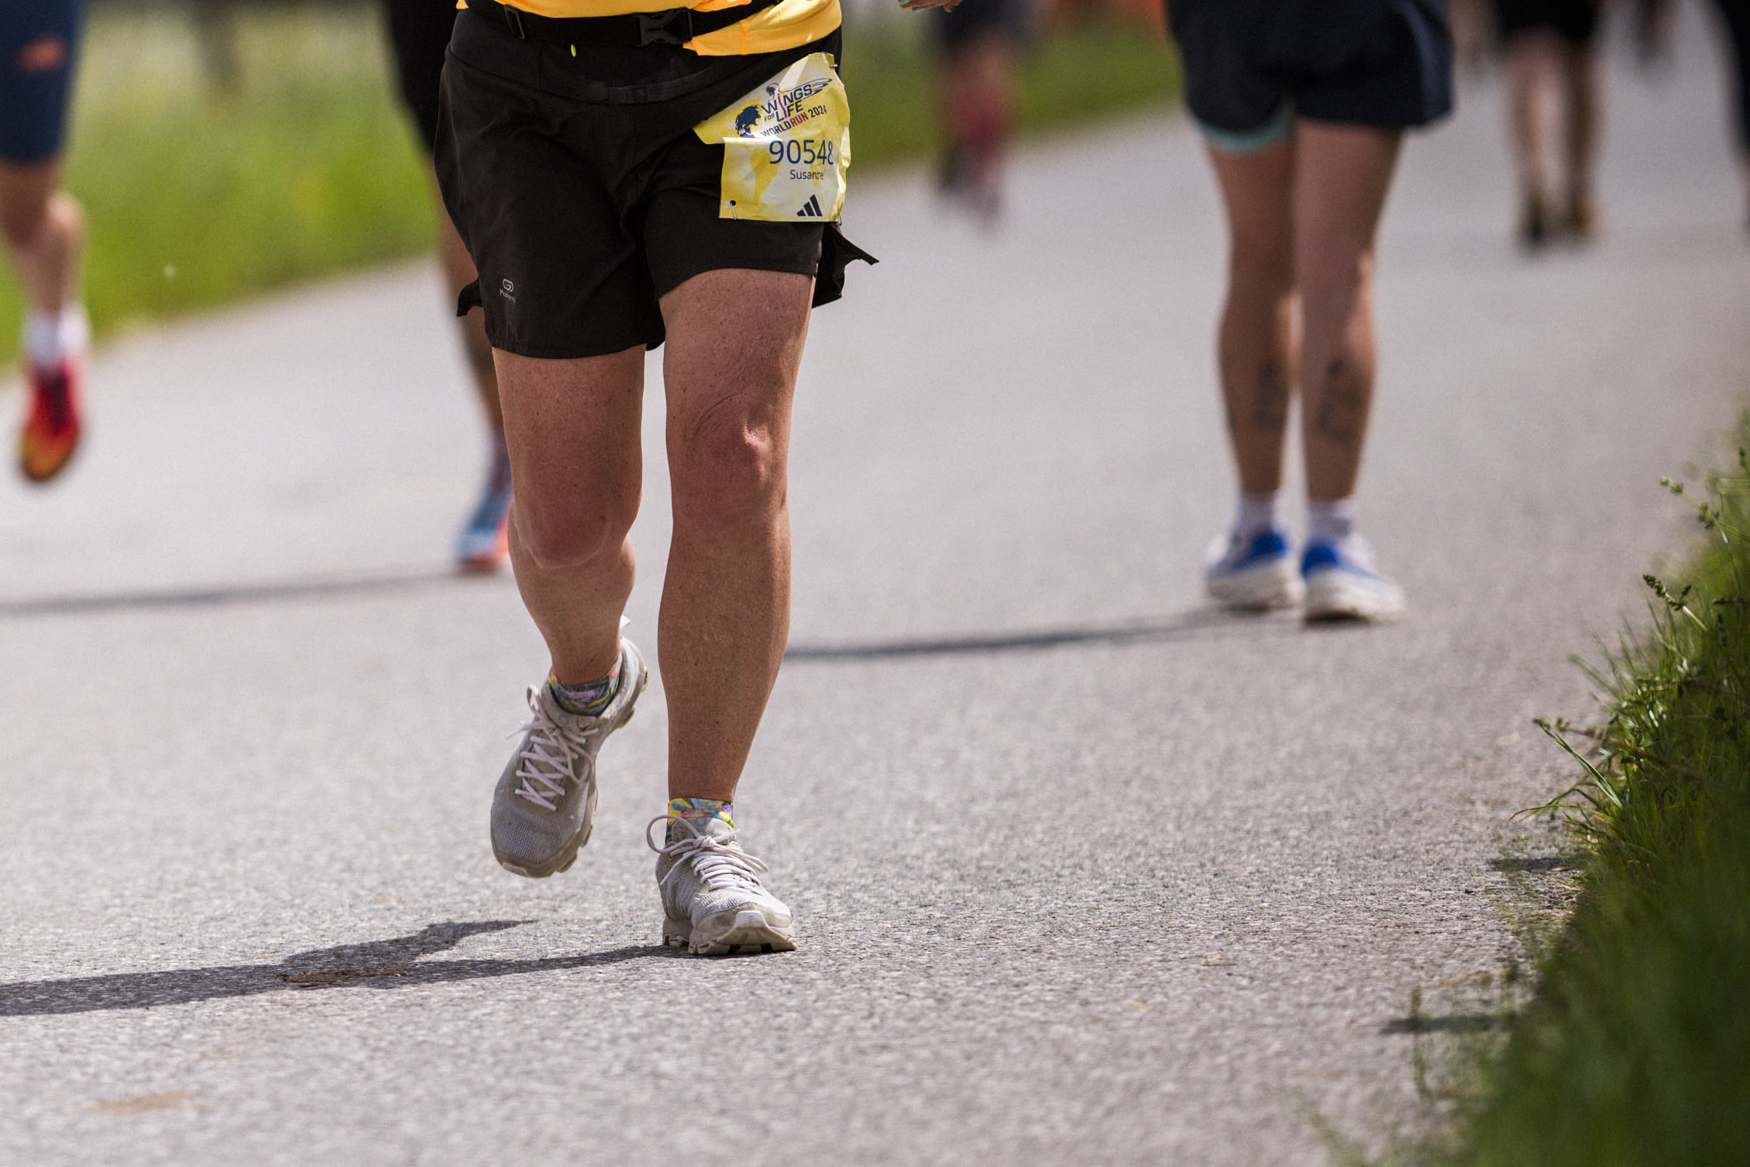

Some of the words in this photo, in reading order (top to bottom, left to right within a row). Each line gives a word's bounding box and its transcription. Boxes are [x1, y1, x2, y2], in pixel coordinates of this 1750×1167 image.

[760, 84, 813, 114] WINGS
[764, 112, 776, 122] FOR
[775, 99, 804, 122] LIFE
